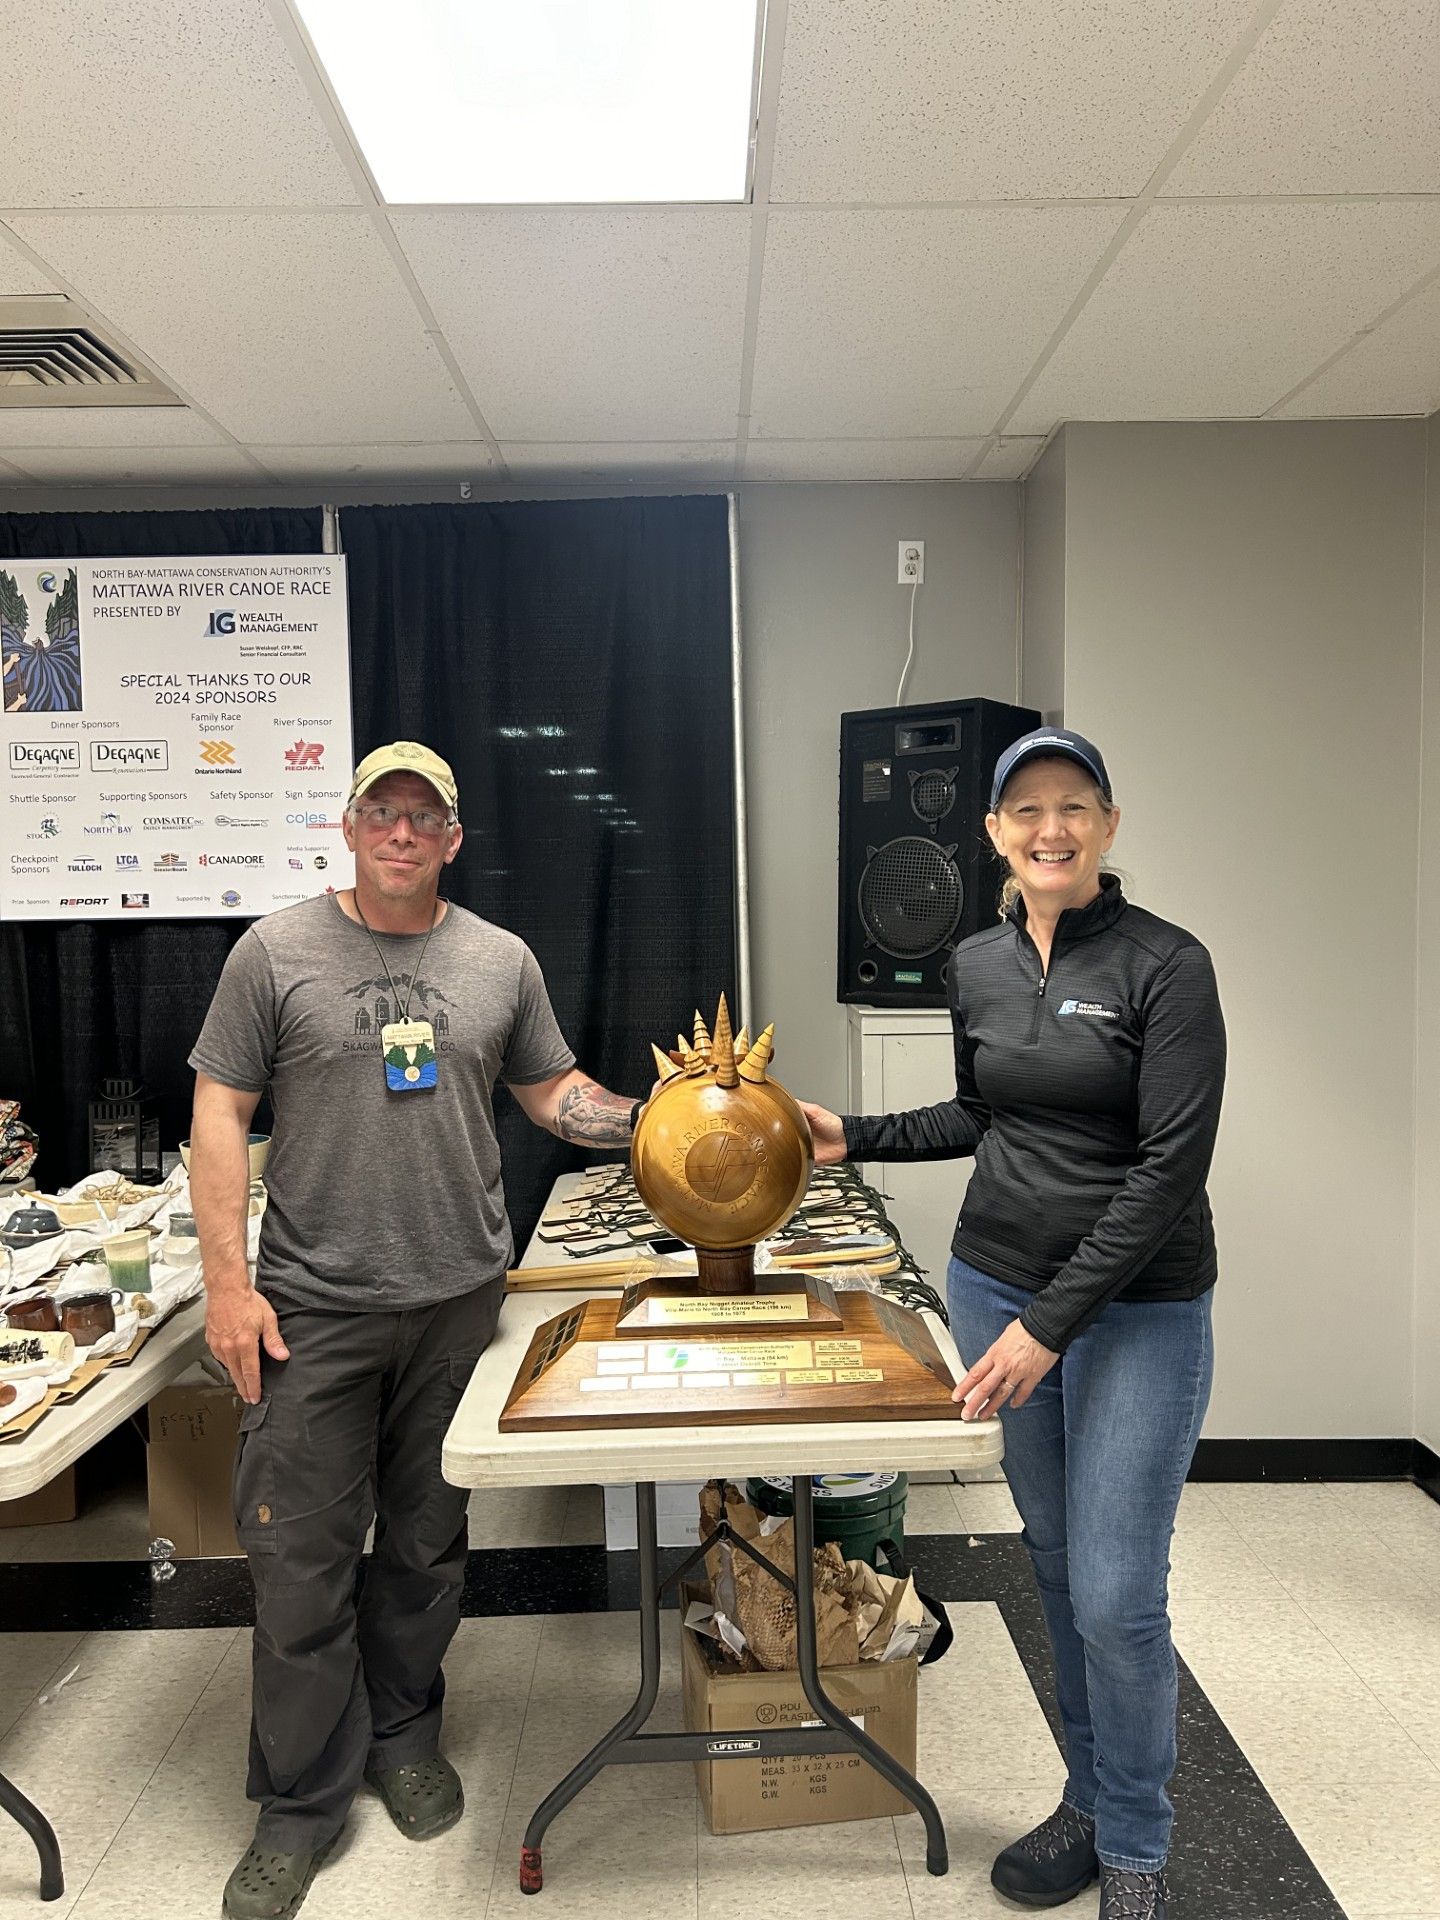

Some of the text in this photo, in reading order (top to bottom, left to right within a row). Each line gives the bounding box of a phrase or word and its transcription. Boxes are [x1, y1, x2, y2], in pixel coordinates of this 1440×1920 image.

[92, 566, 331, 579] NORTH BAY-MATTAWA CONSERVATION AUTHORITY'S
[92, 582, 332, 598] MATTAWA RIVER CANOE RACE
[93, 606, 181, 618] PRESENTED BY
[240, 613, 283, 622] WEALTH
[210, 612, 236, 634] IG
[240, 623, 318, 632] MANAGEMENT
[120, 672, 312, 688] SPECIAL THANKS TO OUR
[155, 690, 277, 704] 2024 SPONSORS
[191, 713, 242, 722] Family Race
[274, 718, 332, 727] River Sponsor
[82, 720, 120, 730] Sponsors
[198, 724, 234, 733] Sponsor
[10, 794, 76, 804] Shuttle Sponsor
[100, 792, 188, 803] Supporting Sponsors
[210, 790, 274, 800] Safety Sponsor
[285, 790, 342, 800] Sign Sponsor
[143, 816, 194, 825] COMSATEC
[286, 811, 328, 825] coles
[84, 826, 112, 834] NORTH
[11, 854, 58, 864] Checkpoint
[116, 855, 139, 865] LTCA
[208, 855, 264, 864] CANADORE
[11, 865, 50, 874] Sponsors
[1078, 1002, 1102, 1010] WEALTH
[684, 1117, 730, 1144] RIVER
[734, 1122, 768, 1174] CANOE
[730, 1179, 765, 1214] RACE
[714, 1741, 754, 1750] LIFETIME
[826, 1762, 831, 1770] X
[762, 1774, 827, 1788] N.W. KGS
[762, 1786, 827, 1799] G.W. KGS
